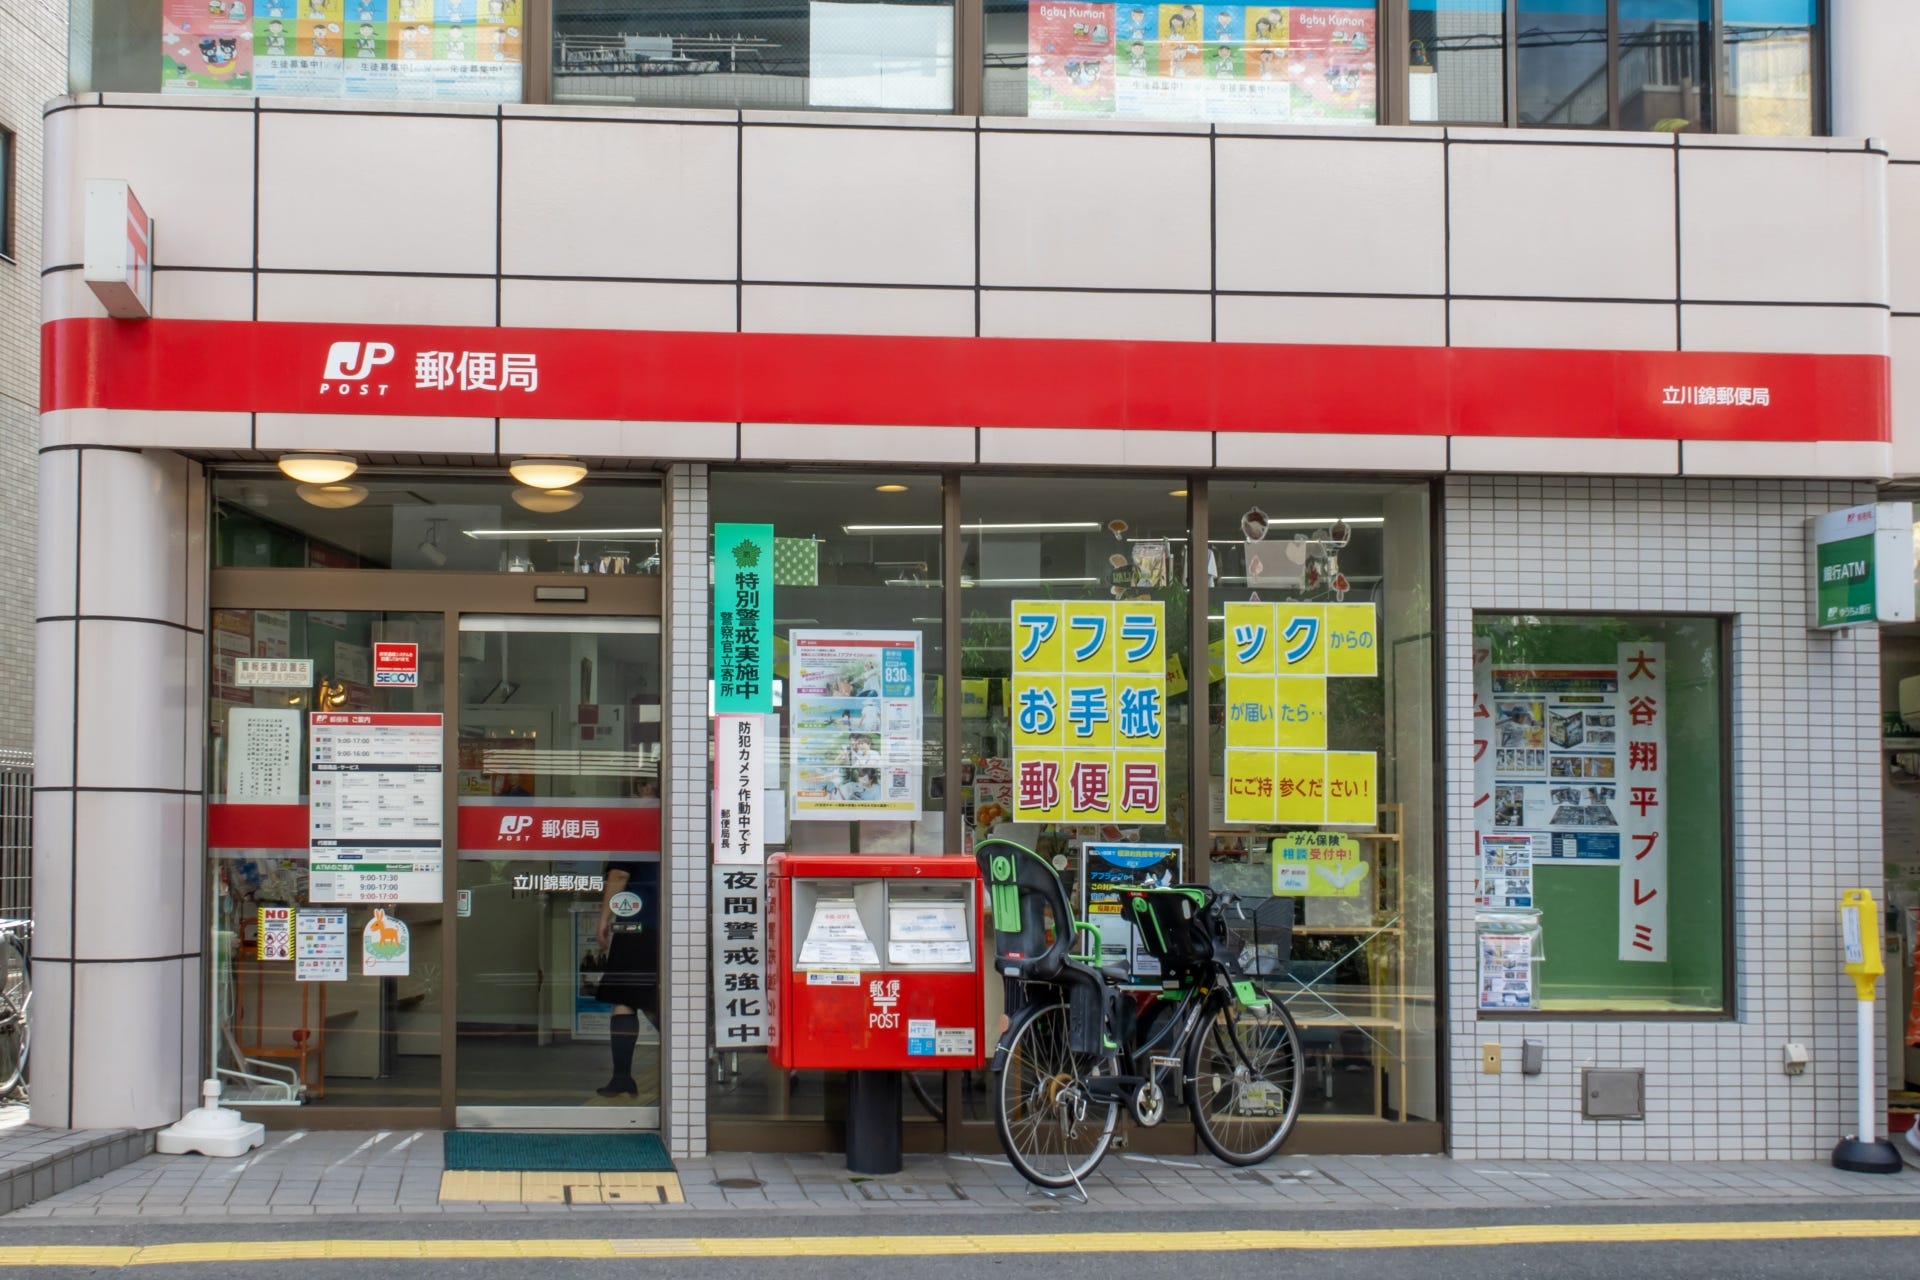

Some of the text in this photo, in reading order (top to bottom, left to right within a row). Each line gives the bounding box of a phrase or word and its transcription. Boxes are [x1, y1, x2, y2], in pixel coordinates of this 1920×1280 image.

[1040, 6, 1106, 20] Baby Kumon
[1299, 14, 1365, 28] Baby Kumon
[415, 350, 538, 392] 郵便局
[320, 382, 391, 396] POST
[1662, 385, 1770, 407] 立川錦郵便局
[1823, 560, 1865, 582] 銀行ATM
[735, 572, 760, 700] 特別警戒実施中
[720, 611, 734, 697] 警察官立寄所
[376, 673, 415, 683] SECOM
[885, 667, 907, 683] 830
[351, 716, 371, 724] ご案内
[1018, 686, 1161, 738] お手紙
[738, 721, 751, 855] 防犯カメラ作動中です
[1018, 761, 1160, 812] 郵便局
[1627, 650, 1660, 952] 大谷翔平プレミ
[541, 819, 600, 839] 郵便局
[721, 809, 730, 848] 郵便局長
[1282, 848, 1352, 860] 相談受付中!
[513, 874, 605, 892] 立川錦郵便局
[265, 910, 288, 919] NO
[723, 871, 760, 1042] 夜間警戒強化中
[869, 980, 900, 998] 郵便
[869, 1012, 900, 1029] POST
